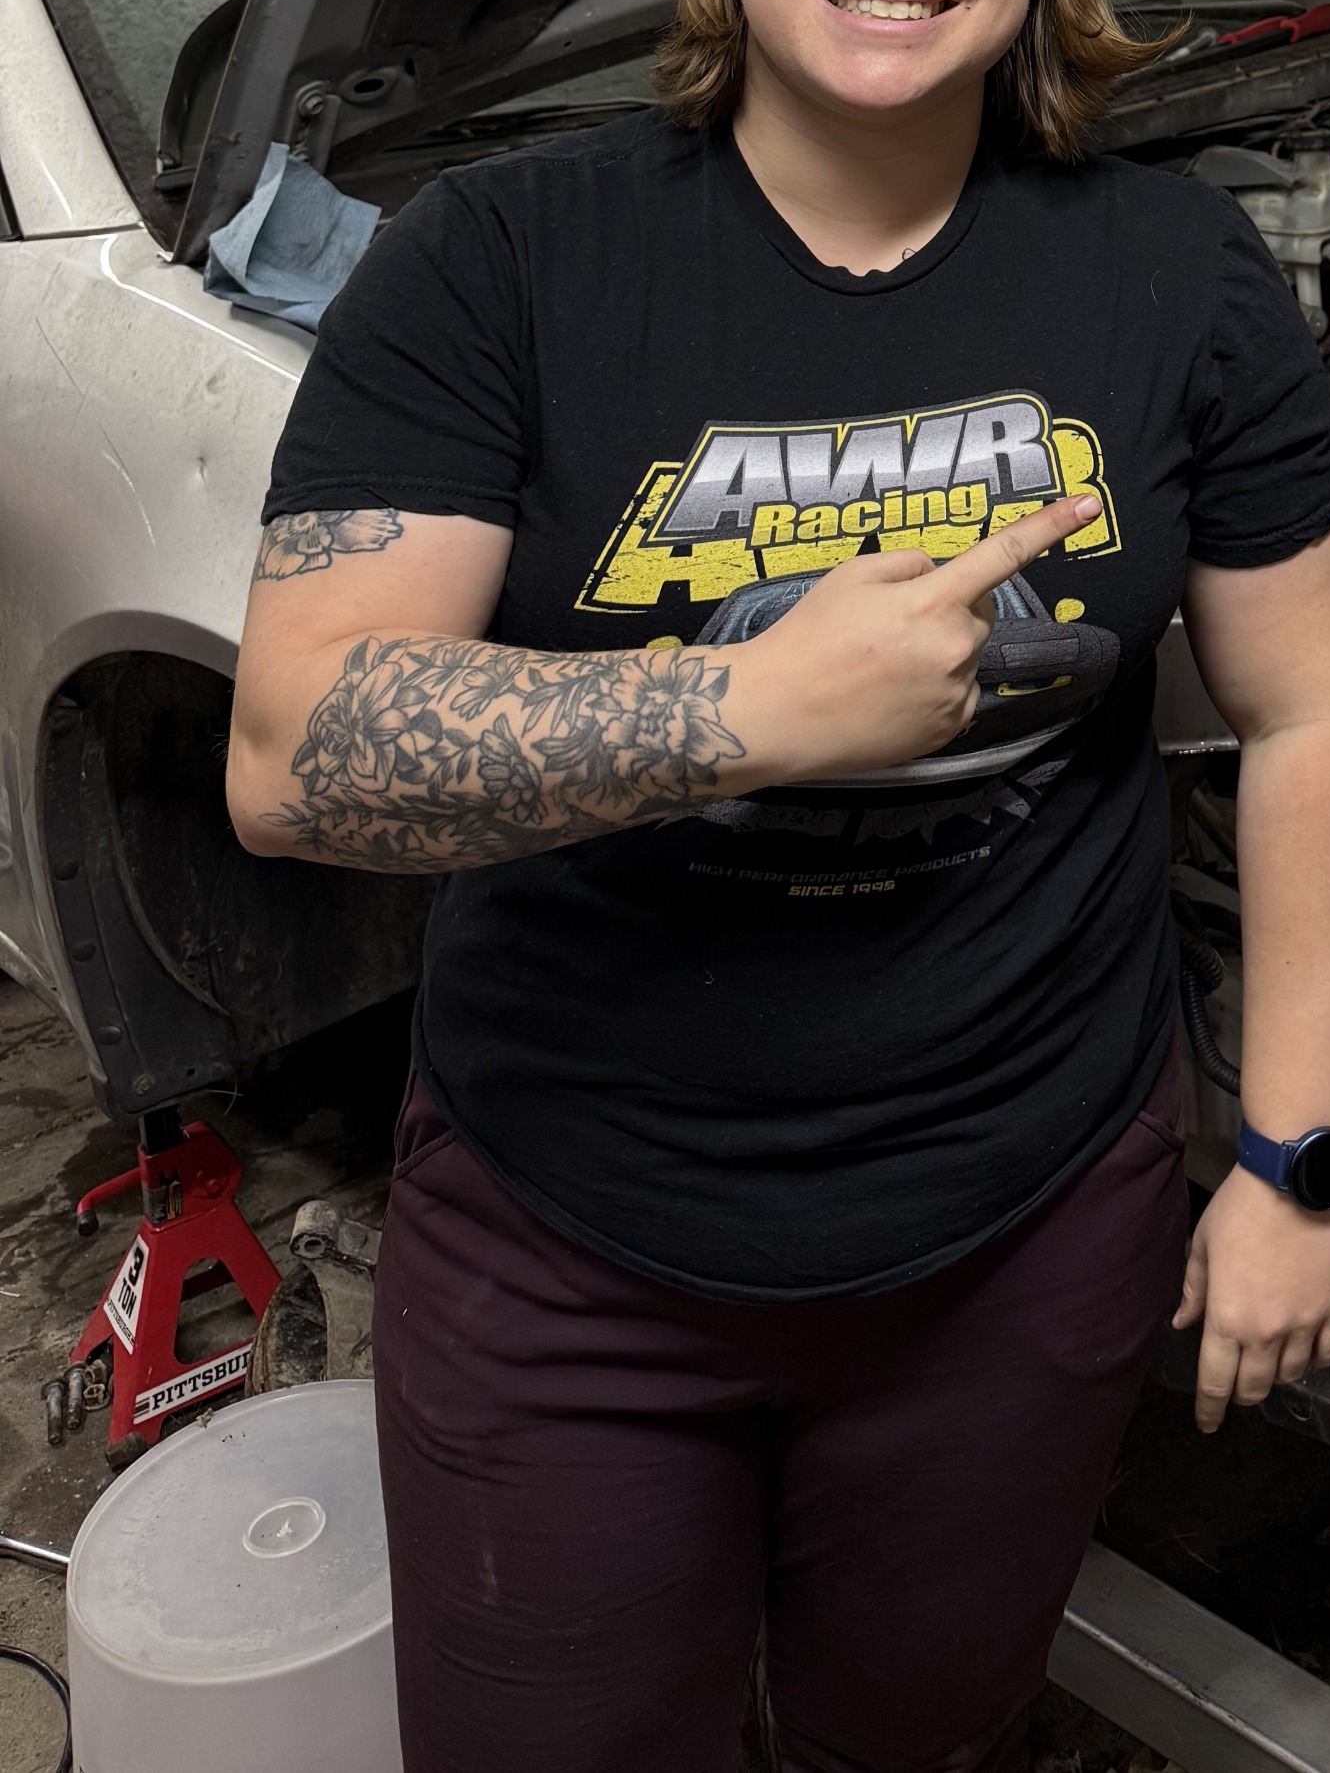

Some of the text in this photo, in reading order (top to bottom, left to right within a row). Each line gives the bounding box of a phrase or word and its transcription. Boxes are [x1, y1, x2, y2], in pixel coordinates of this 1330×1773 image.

[663, 402, 1052, 532] AWR
[751, 483, 988, 546] Racing
[689, 846, 990, 883] HIGH PERFORMANCE PRODUCTS
[788, 885, 845, 897] SINCE
[128, 1247, 144, 1286] 3
[118, 1277, 137, 1319] TON
